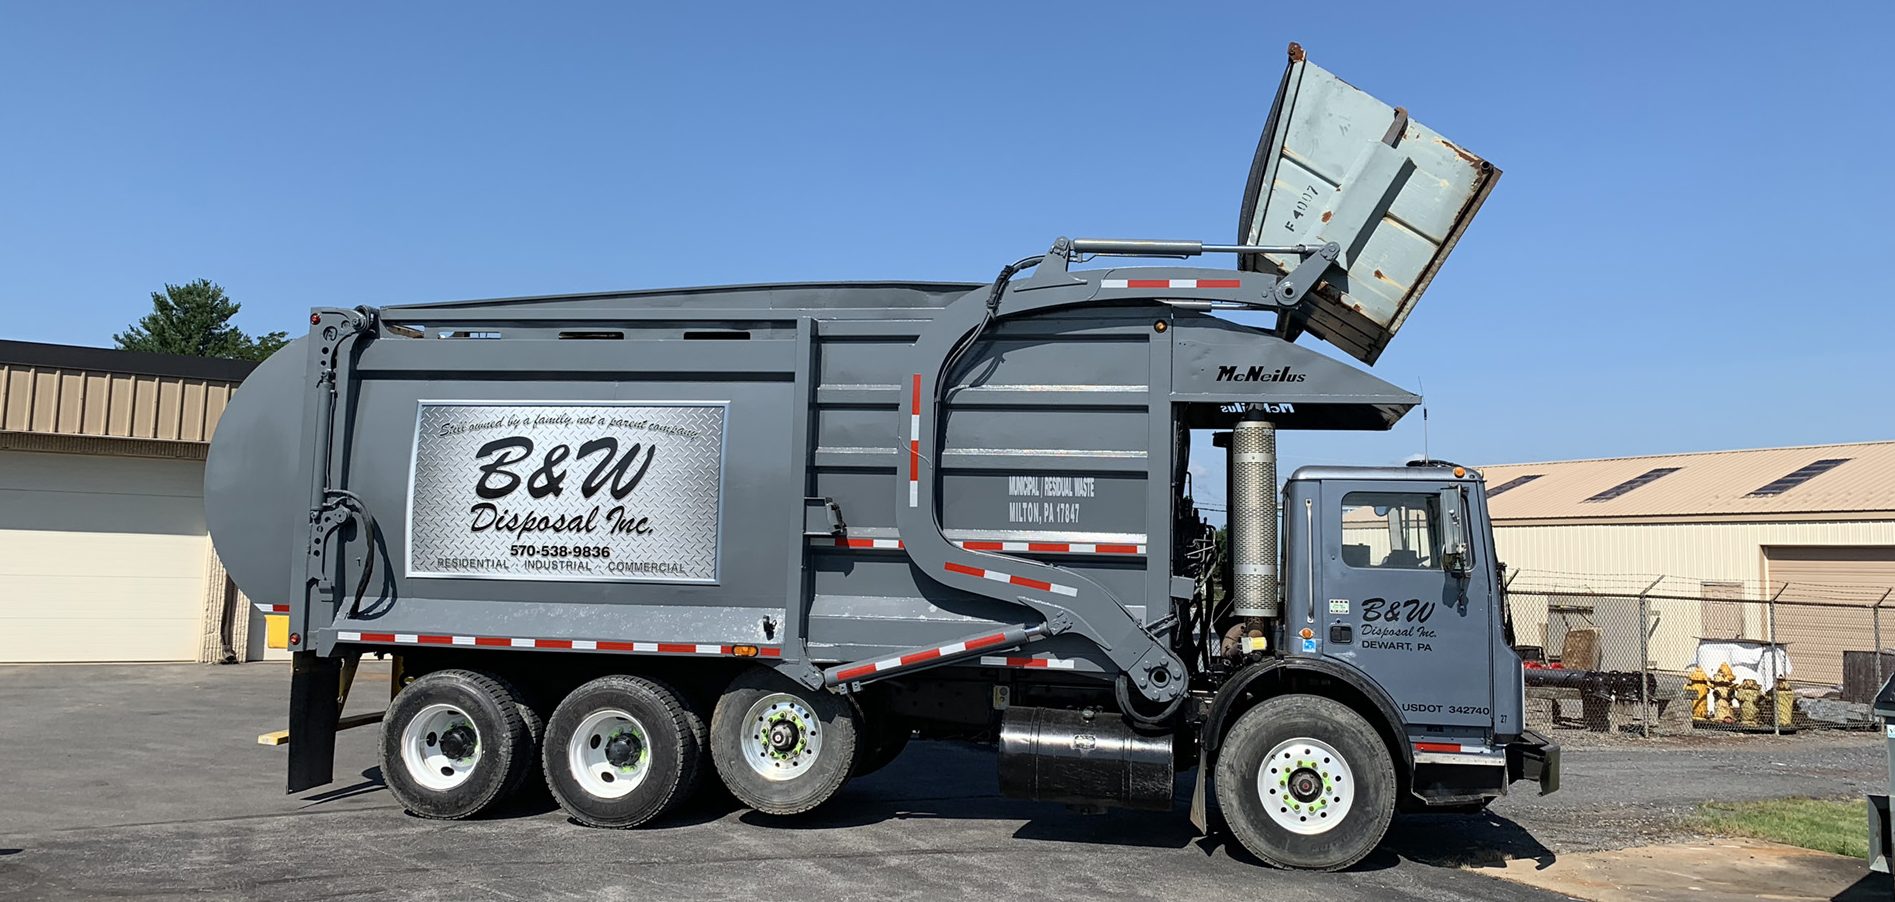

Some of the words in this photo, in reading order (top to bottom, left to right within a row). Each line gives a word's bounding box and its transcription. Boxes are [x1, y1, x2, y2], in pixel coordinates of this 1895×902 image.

[1216, 366, 1306, 383] McNeilus
[440, 422, 468, 437] Still
[468, 416, 505, 433] owned
[507, 413, 522, 429] by
[522, 416, 531, 425] a
[576, 414, 597, 425] not
[597, 416, 606, 425] a
[607, 416, 648, 430] parent
[475, 436, 656, 500] B&W
[1008, 476, 1040, 496] MUNICIPAL
[1044, 476, 1073, 497] RESIDUAL
[1074, 477, 1095, 497] WASTE
[470, 502, 600, 541] Disposal
[606, 505, 654, 535] Inc.
[1009, 502, 1042, 525] MILTON,
[1043, 502, 1055, 523] PA
[1057, 503, 1080, 523] 17847
[510, 545, 611, 558] 570-538-9836
[437, 558, 510, 569] RESIDENTIAL
[524, 560, 592, 571] INDUSTRIAL
[608, 562, 685, 573] COMMERCIAL
[1361, 597, 1436, 623] B&W
[1361, 624, 1415, 638] Disposal
[1417, 626, 1437, 638] Inc.
[1362, 640, 1413, 651] DEWART,
[1417, 643, 1433, 652] PA
[1402, 703, 1444, 713] USDOT
[1448, 705, 1490, 716] 342740
